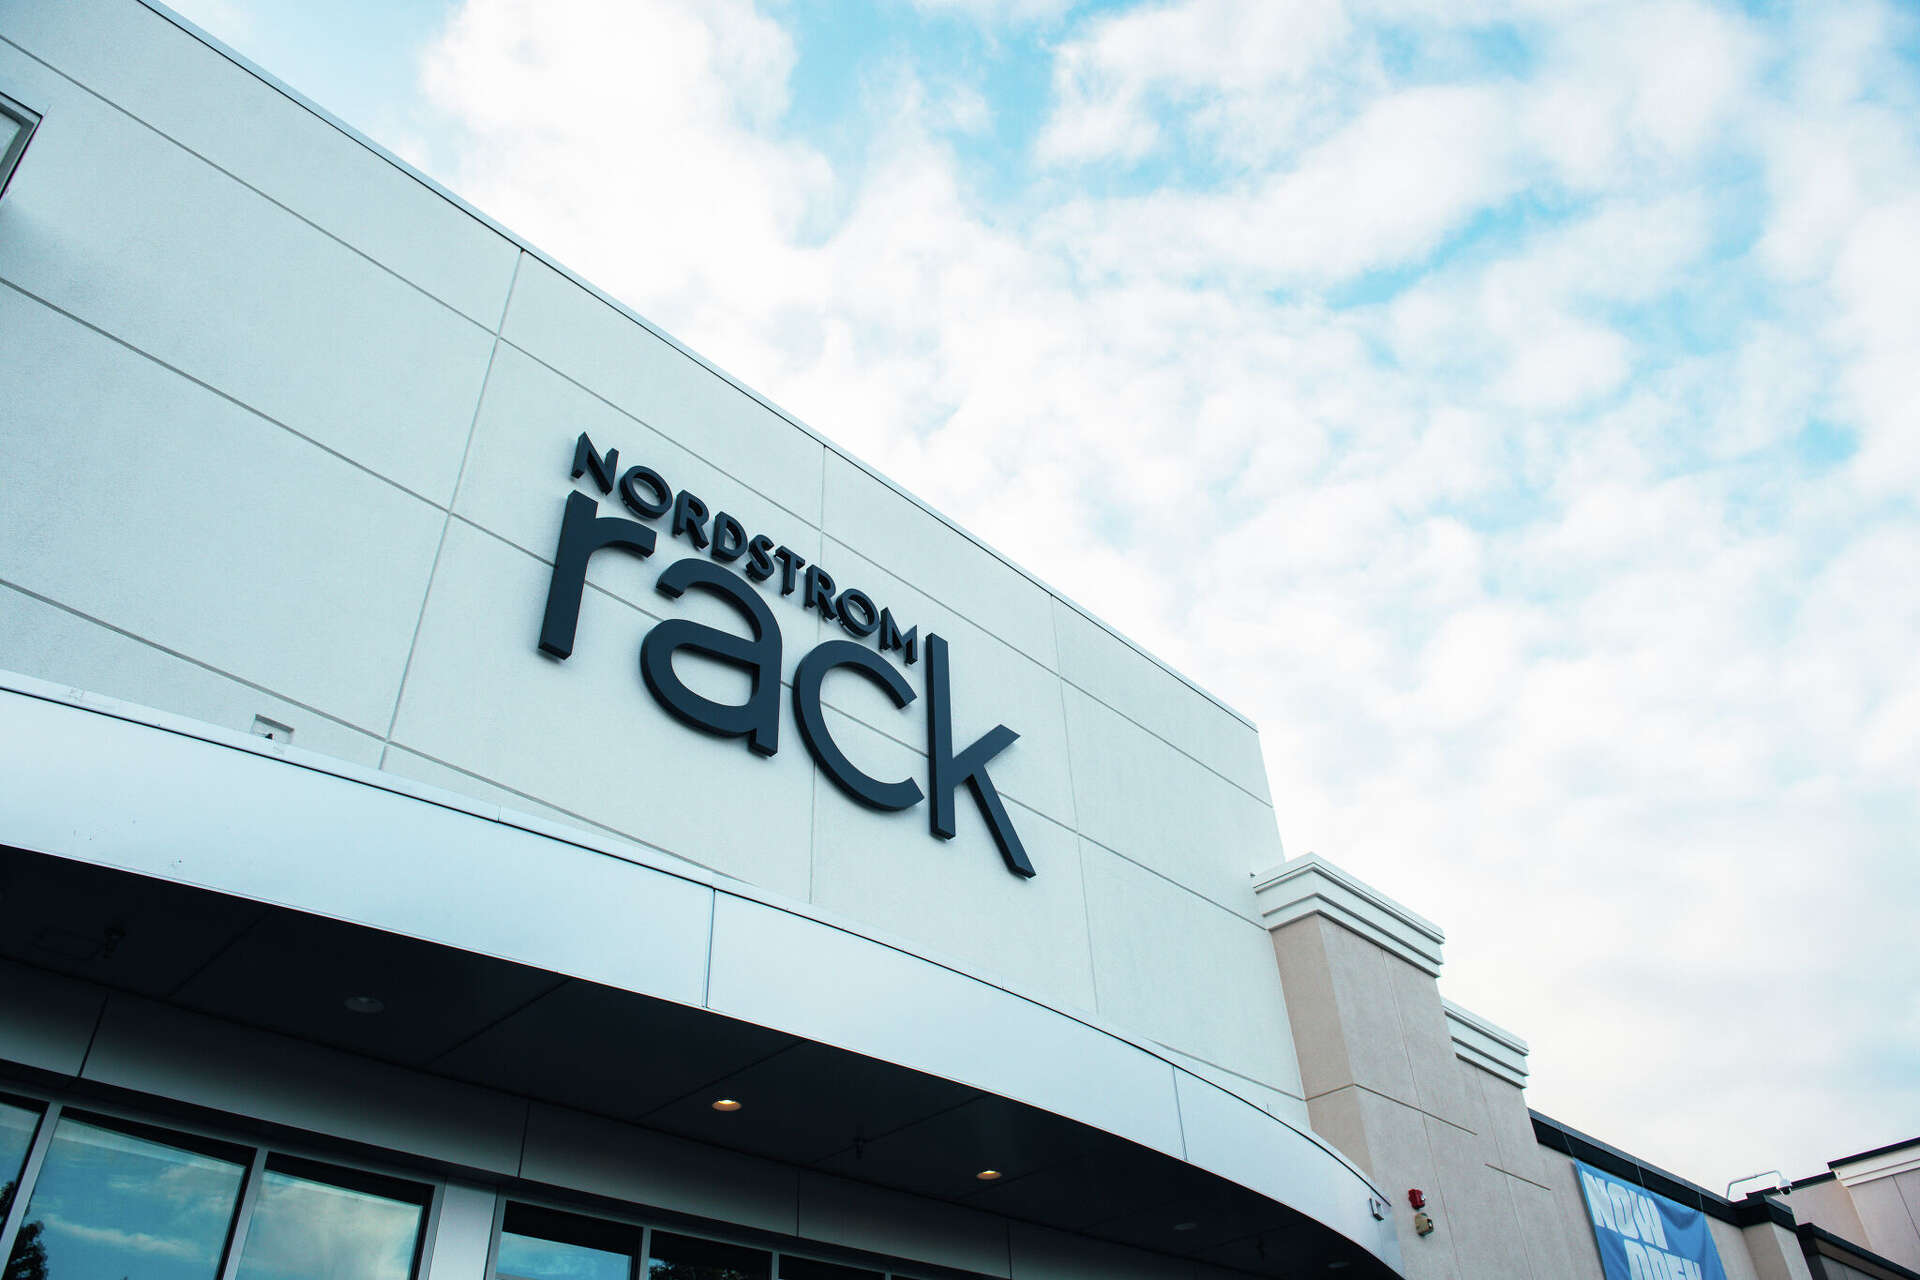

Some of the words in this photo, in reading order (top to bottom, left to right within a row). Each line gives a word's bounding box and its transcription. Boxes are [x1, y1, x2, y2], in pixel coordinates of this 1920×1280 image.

[571, 431, 918, 665] NORDSTROM
[538, 490, 1036, 879] rack
[1582, 1171, 1669, 1250] NOW
